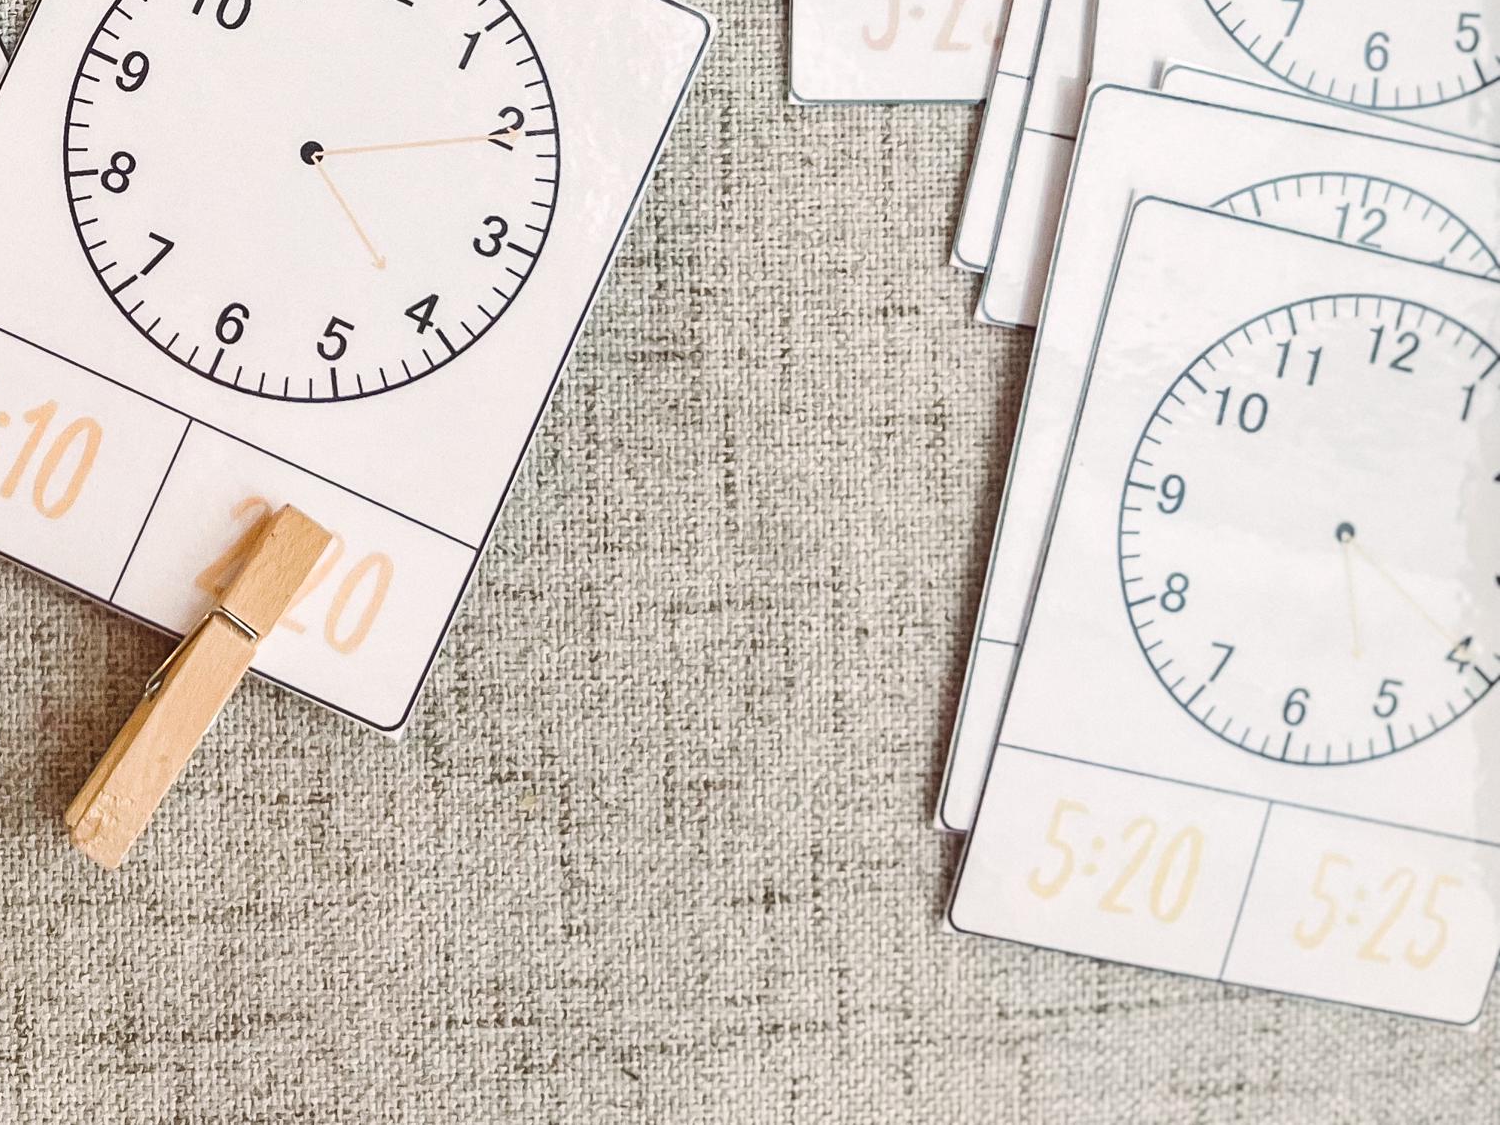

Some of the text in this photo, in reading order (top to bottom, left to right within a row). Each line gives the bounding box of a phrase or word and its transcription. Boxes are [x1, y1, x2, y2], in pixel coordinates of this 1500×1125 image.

[458, 31, 481, 70] 1
[1364, 32, 1390, 71] 6
[1455, 13, 1481, 53] 5
[116, 51, 149, 92] 9
[487, 107, 525, 151] 2
[101, 151, 136, 193] 8
[473, 216, 509, 257] 3
[1335, 202, 1387, 248] 12
[140, 232, 174, 276] 7
[215, 303, 250, 344] 6
[404, 294, 439, 334] 4
[317, 316, 354, 361] 5
[1368, 325, 1420, 373] 12
[1276, 339, 1322, 386] 11
[1214, 386, 1269, 433] 10
[1460, 383, 1476, 422] 1
[1158, 474, 1186, 514] 9
[1160, 573, 1190, 613] 8
[1211, 642, 1235, 682] 7
[1445, 636, 1473, 673] 4
[1283, 688, 1310, 726] 6
[1373, 679, 1403, 718] 5
[1027, 798, 1205, 924] 5:20
[1293, 851, 1463, 969] 5:25
